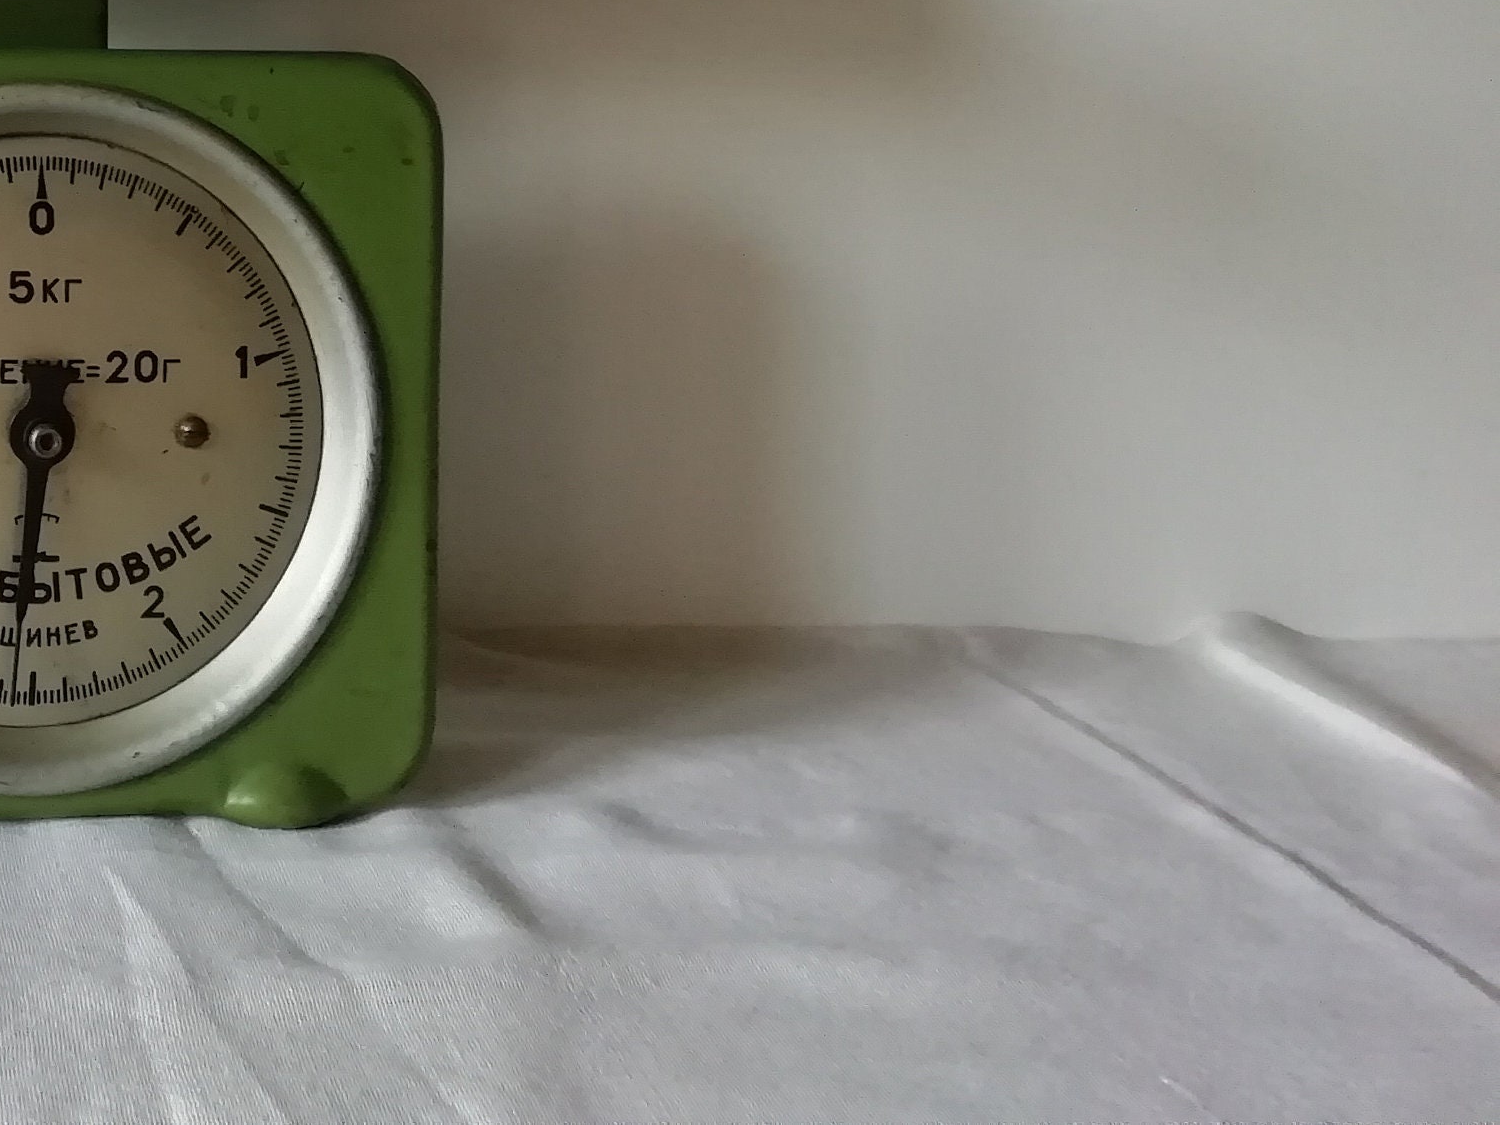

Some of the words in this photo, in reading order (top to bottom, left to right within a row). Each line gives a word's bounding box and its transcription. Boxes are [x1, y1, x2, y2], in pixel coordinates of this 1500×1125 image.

[28, 202, 56, 236] 0
[234, 346, 249, 380] 1
[140, 585, 167, 619] 2
